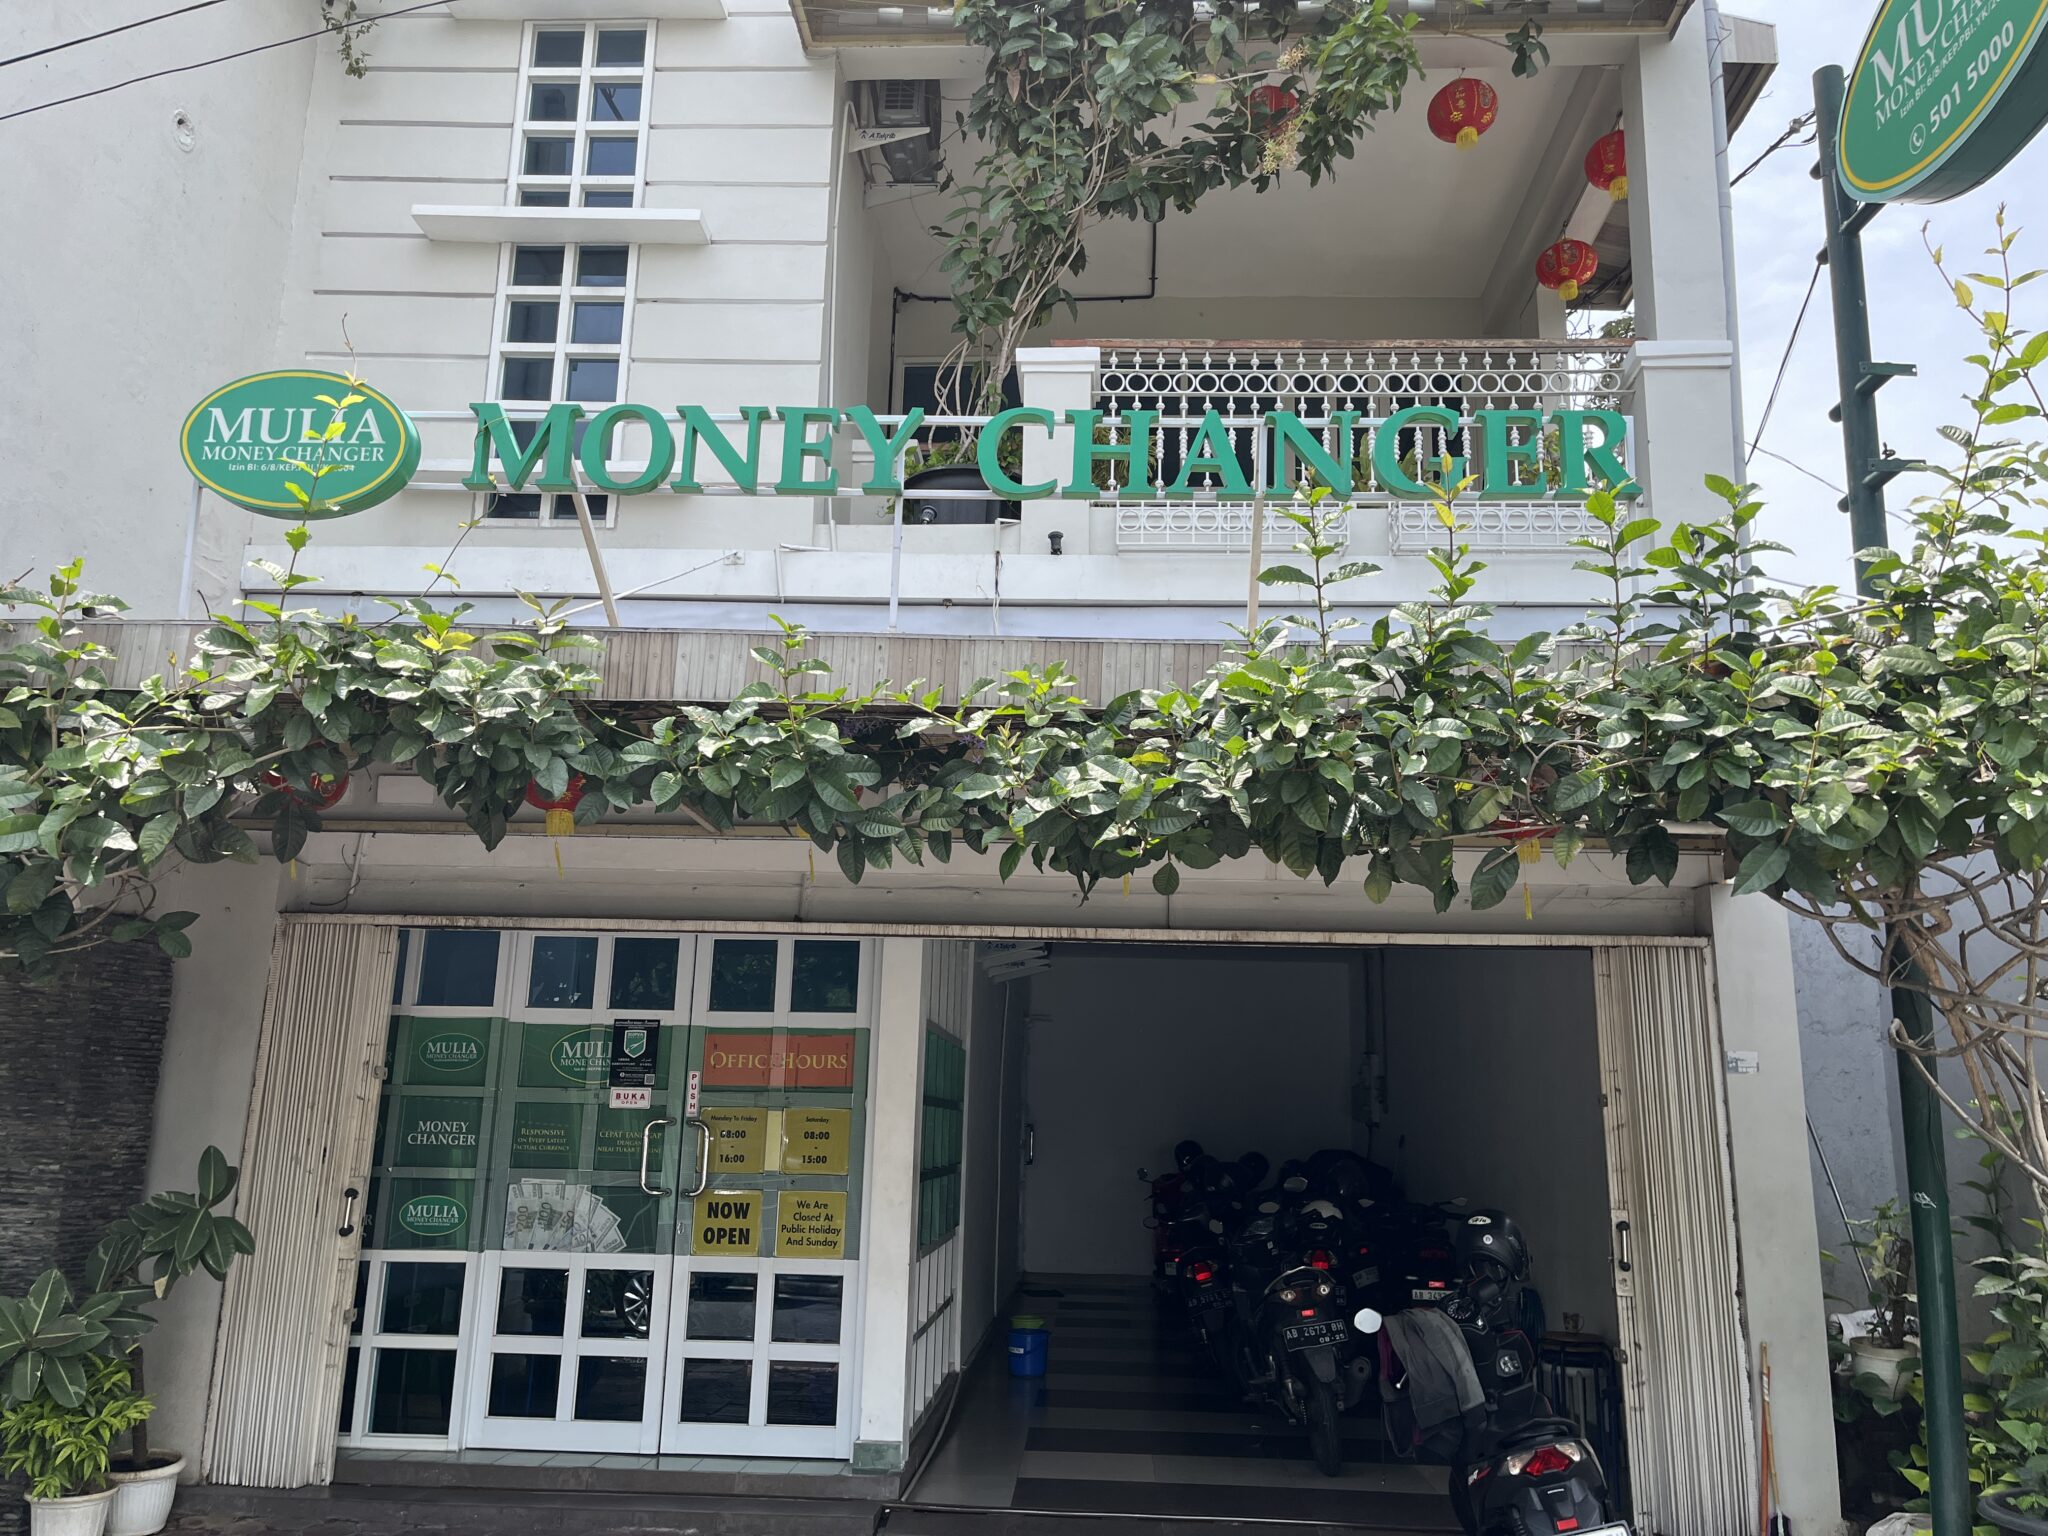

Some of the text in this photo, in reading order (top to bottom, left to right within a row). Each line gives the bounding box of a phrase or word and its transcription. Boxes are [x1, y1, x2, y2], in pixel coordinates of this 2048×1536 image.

[1869, 0, 1960, 107] MU
[1930, 20, 2014, 133] 501 5000
[1874, 39, 1937, 130] MONEY
[1900, 98, 1915, 118] Izin
[204, 407, 386, 444] MULIA
[202, 445, 385, 462] MONEY CHANGER
[461, 402, 1643, 502] MONEY CHANGER
[228, 463, 245, 471] Izin
[247, 463, 260, 471] BI:
[427, 1042, 477, 1054] MULIA
[561, 1041, 613, 1058] MULI
[560, 1058, 587, 1066] MONE
[710, 1051, 848, 1069] OFFIC HOURS
[689, 1073, 698, 1110] PUSH
[711, 1115, 733, 1123] Monday
[741, 1115, 758, 1123] Friday
[806, 1116, 829, 1124] Saturday
[417, 1121, 470, 1133] MONEY
[407, 1133, 476, 1146] CHANGER
[599, 1131, 624, 1139] CEPAT
[720, 1130, 746, 1139] 08:00
[804, 1131, 830, 1140] 08:00
[719, 1154, 745, 1163] 16:00
[802, 1155, 828, 1164] 15:00
[407, 1205, 458, 1217] MULIA
[707, 1201, 751, 1219] NOW
[796, 1200, 828, 1210] We Are
[793, 1213, 834, 1222] Closed At
[703, 1227, 750, 1245] OPEN
[781, 1224, 842, 1236] Public Holiday
[786, 1236, 838, 1249] And Sunday
[1286, 1328, 1298, 1340] AB
[1303, 1325, 1327, 1336] 2673
